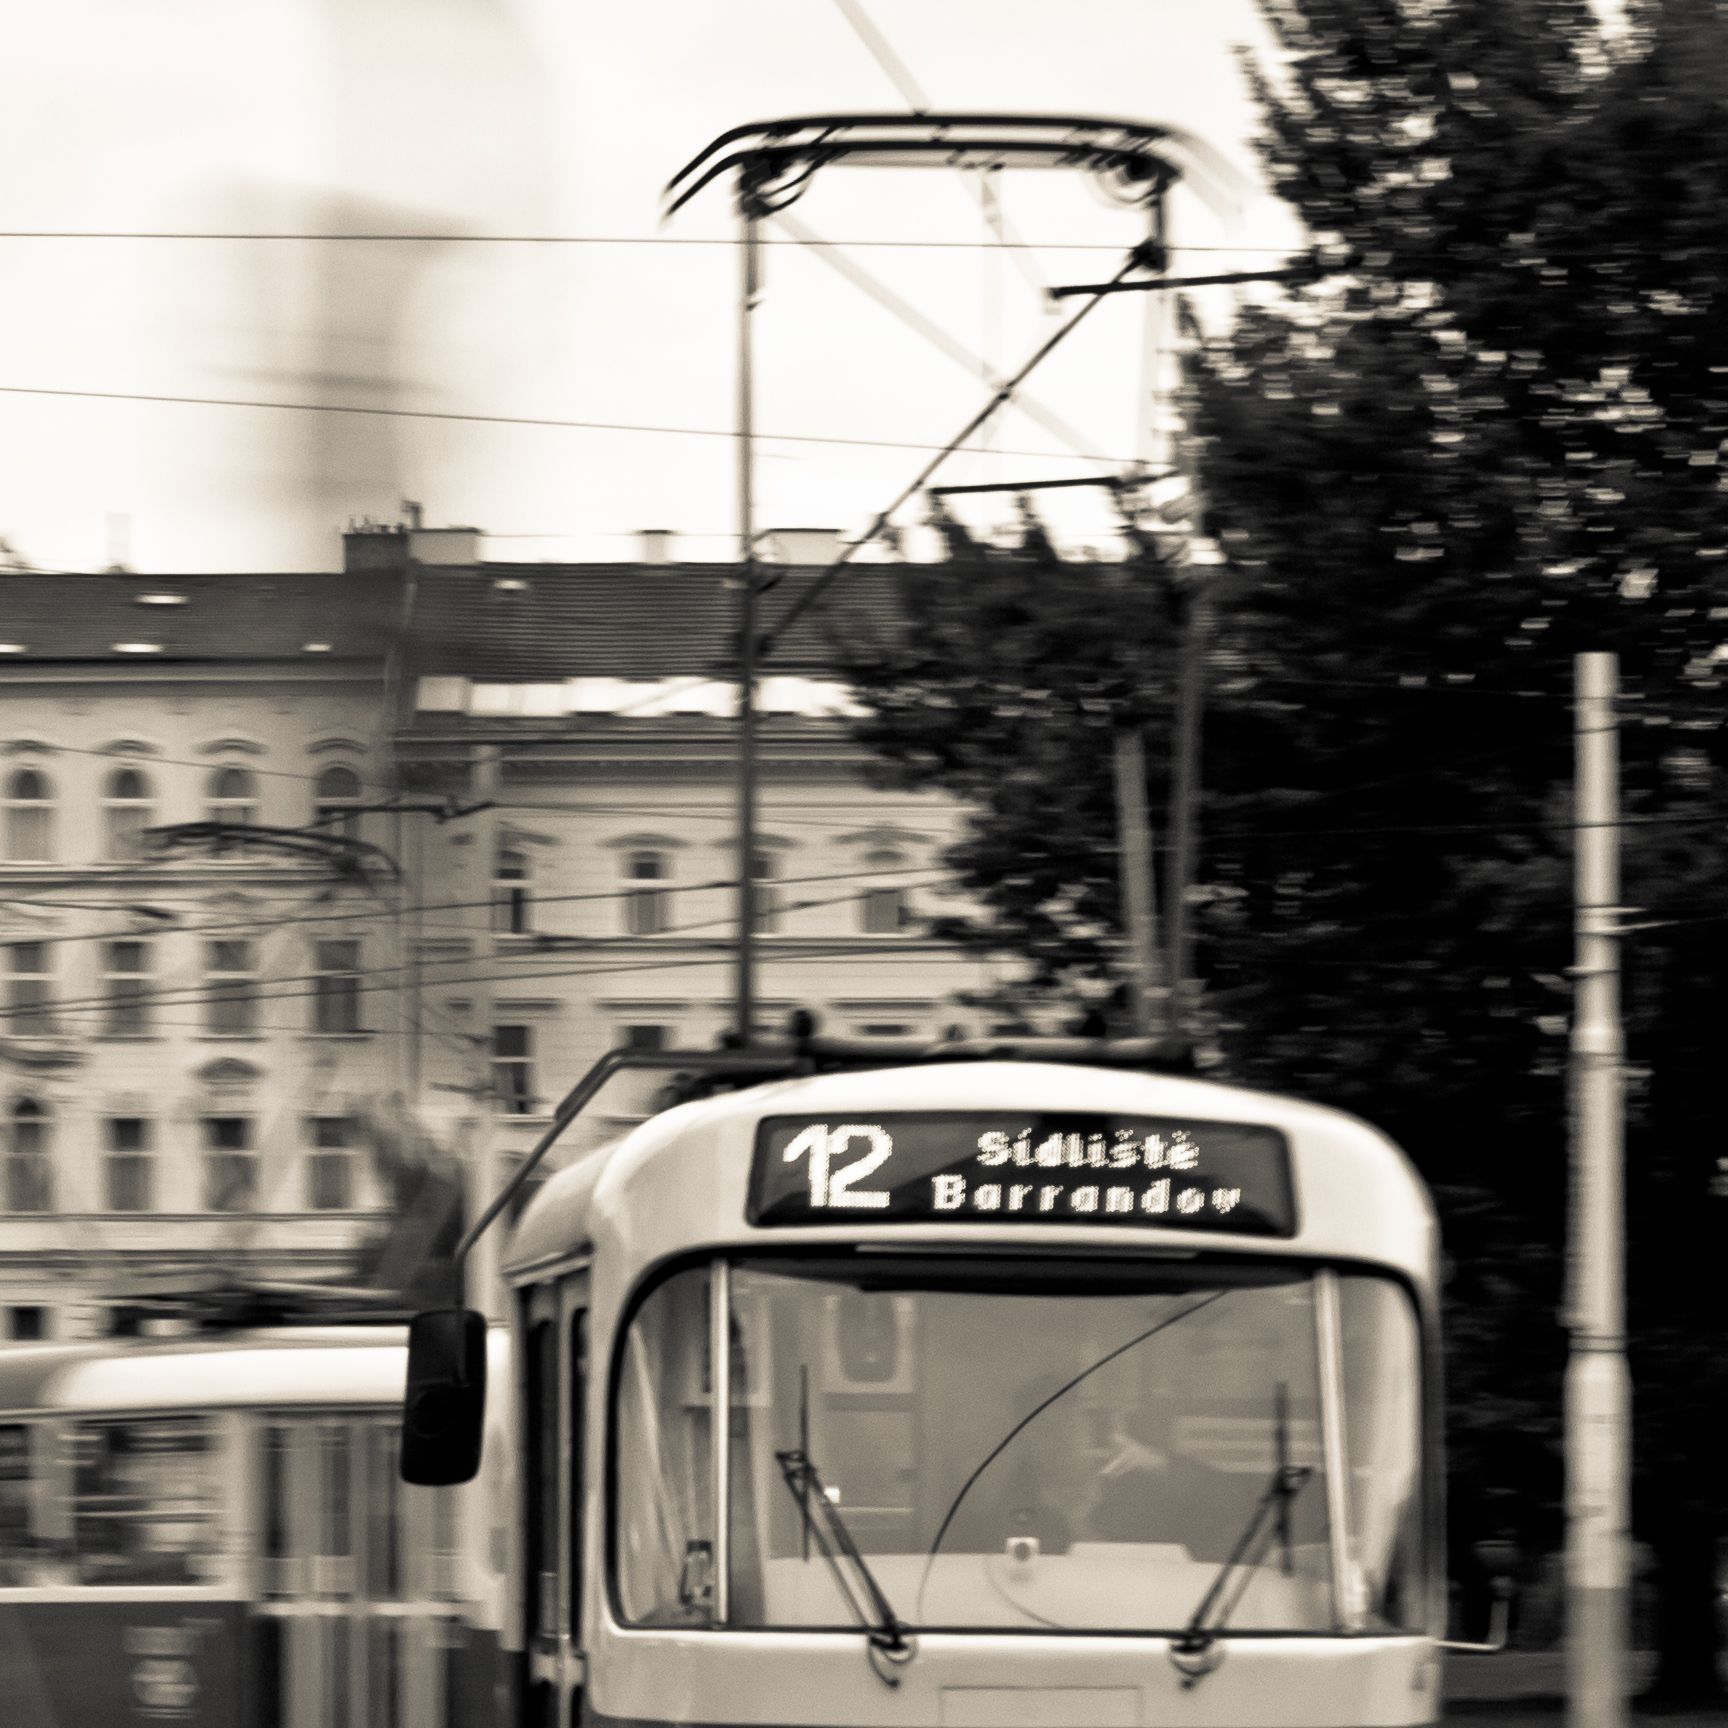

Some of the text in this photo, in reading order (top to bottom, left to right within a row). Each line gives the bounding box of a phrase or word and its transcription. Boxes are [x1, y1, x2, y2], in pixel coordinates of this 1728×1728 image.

[782, 1123, 894, 1208] 12
[976, 1127, 1200, 1169] Sídliště
[930, 1173, 1242, 1214] Barrandov
